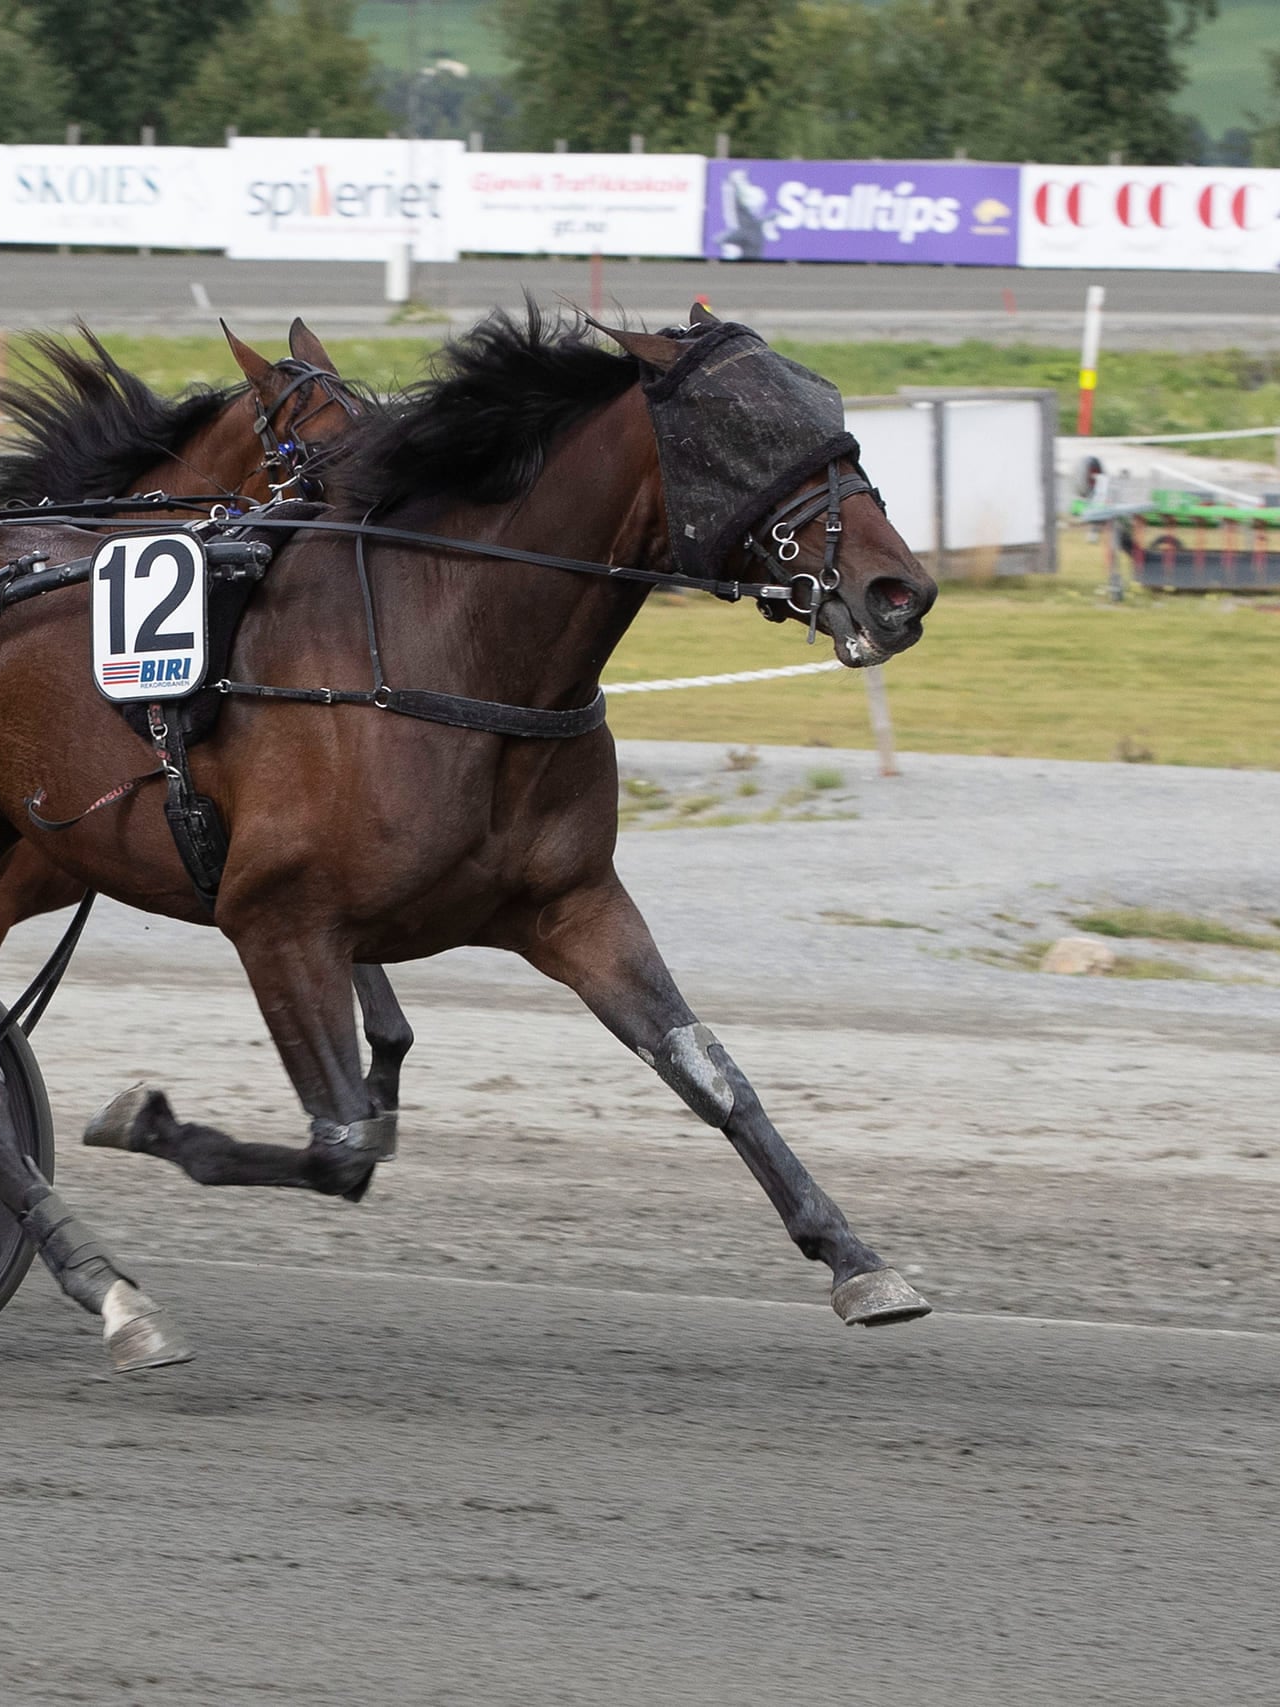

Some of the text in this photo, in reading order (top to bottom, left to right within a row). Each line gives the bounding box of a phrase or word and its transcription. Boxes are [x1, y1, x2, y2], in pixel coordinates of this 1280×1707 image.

[776, 180, 961, 244] Stalltips
[98, 538, 195, 655] 12
[140, 657, 191, 682] BIRI
